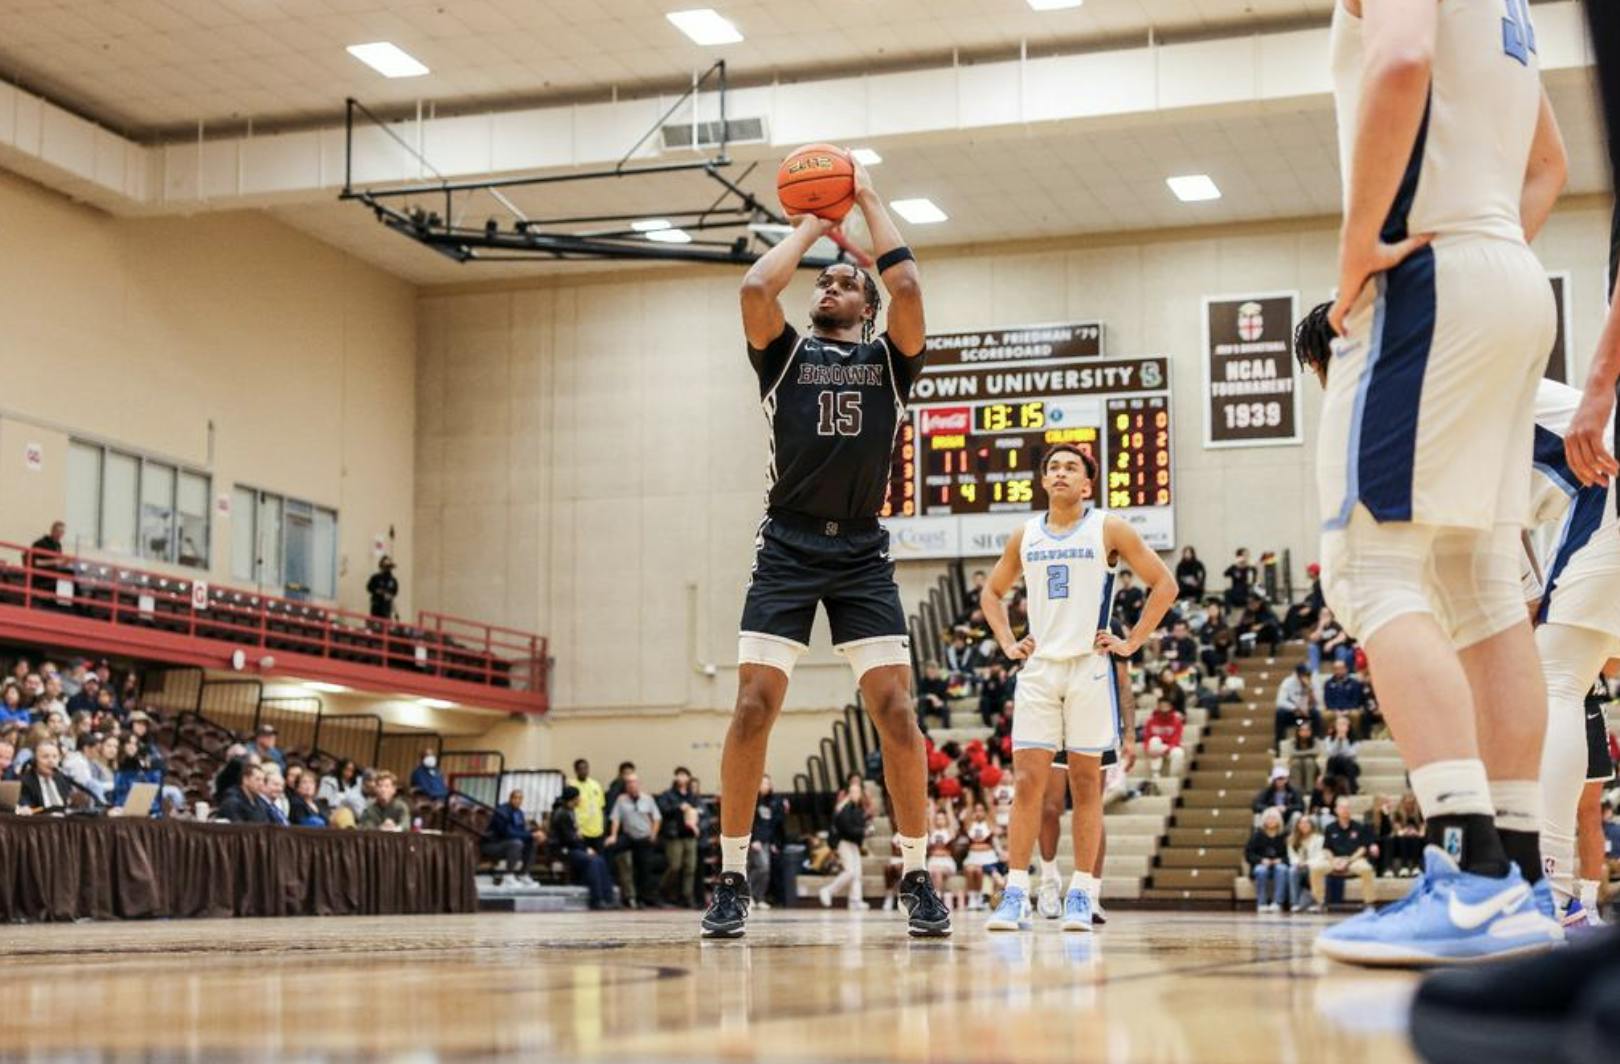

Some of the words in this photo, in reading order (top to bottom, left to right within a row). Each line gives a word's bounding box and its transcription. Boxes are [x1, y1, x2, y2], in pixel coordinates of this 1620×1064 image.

[926, 334, 981, 350] ICHARD
[1003, 328, 1072, 346] FRIEDMAN
[960, 345, 1052, 362] SCOREBOARD
[797, 362, 884, 386] BROWN
[1225, 358, 1277, 381] NCAA
[909, 375, 978, 398] OWN
[986, 366, 1134, 394] UNIVERSITY
[1212, 378, 1293, 397] TOURNAMENT
[817, 390, 863, 436] 15
[960, 482, 976, 503] 4
[1027, 547, 1095, 563] COLUMBIA
[1046, 564, 1070, 600] 2
